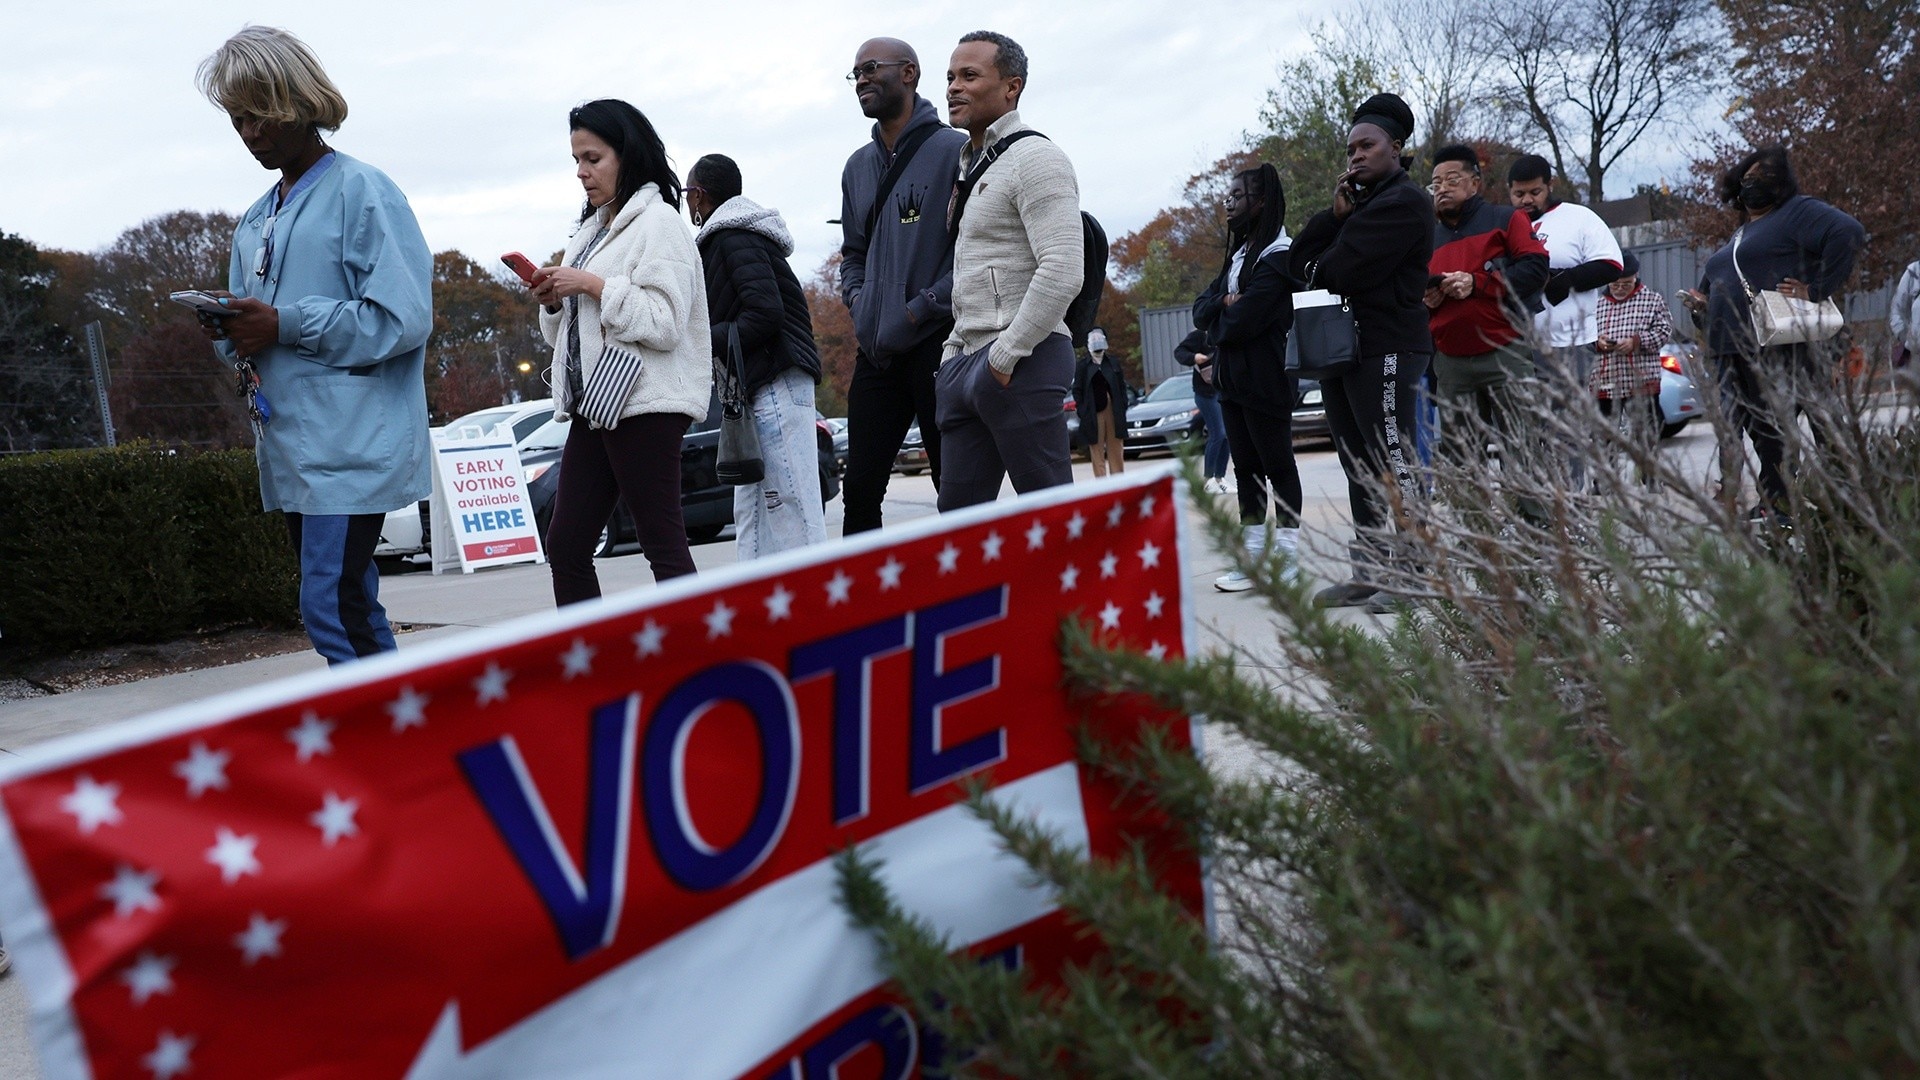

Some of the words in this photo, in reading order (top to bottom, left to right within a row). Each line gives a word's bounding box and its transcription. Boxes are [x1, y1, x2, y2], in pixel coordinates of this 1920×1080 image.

[1383, 381, 1396, 412] PINK
[1384, 416, 1399, 446] PINK
[456, 459, 504, 475] EARLY
[453, 476, 516, 493] VOTING
[458, 493, 520, 508] available
[462, 508, 526, 533] HERE
[456, 583, 1010, 963] VOTE
